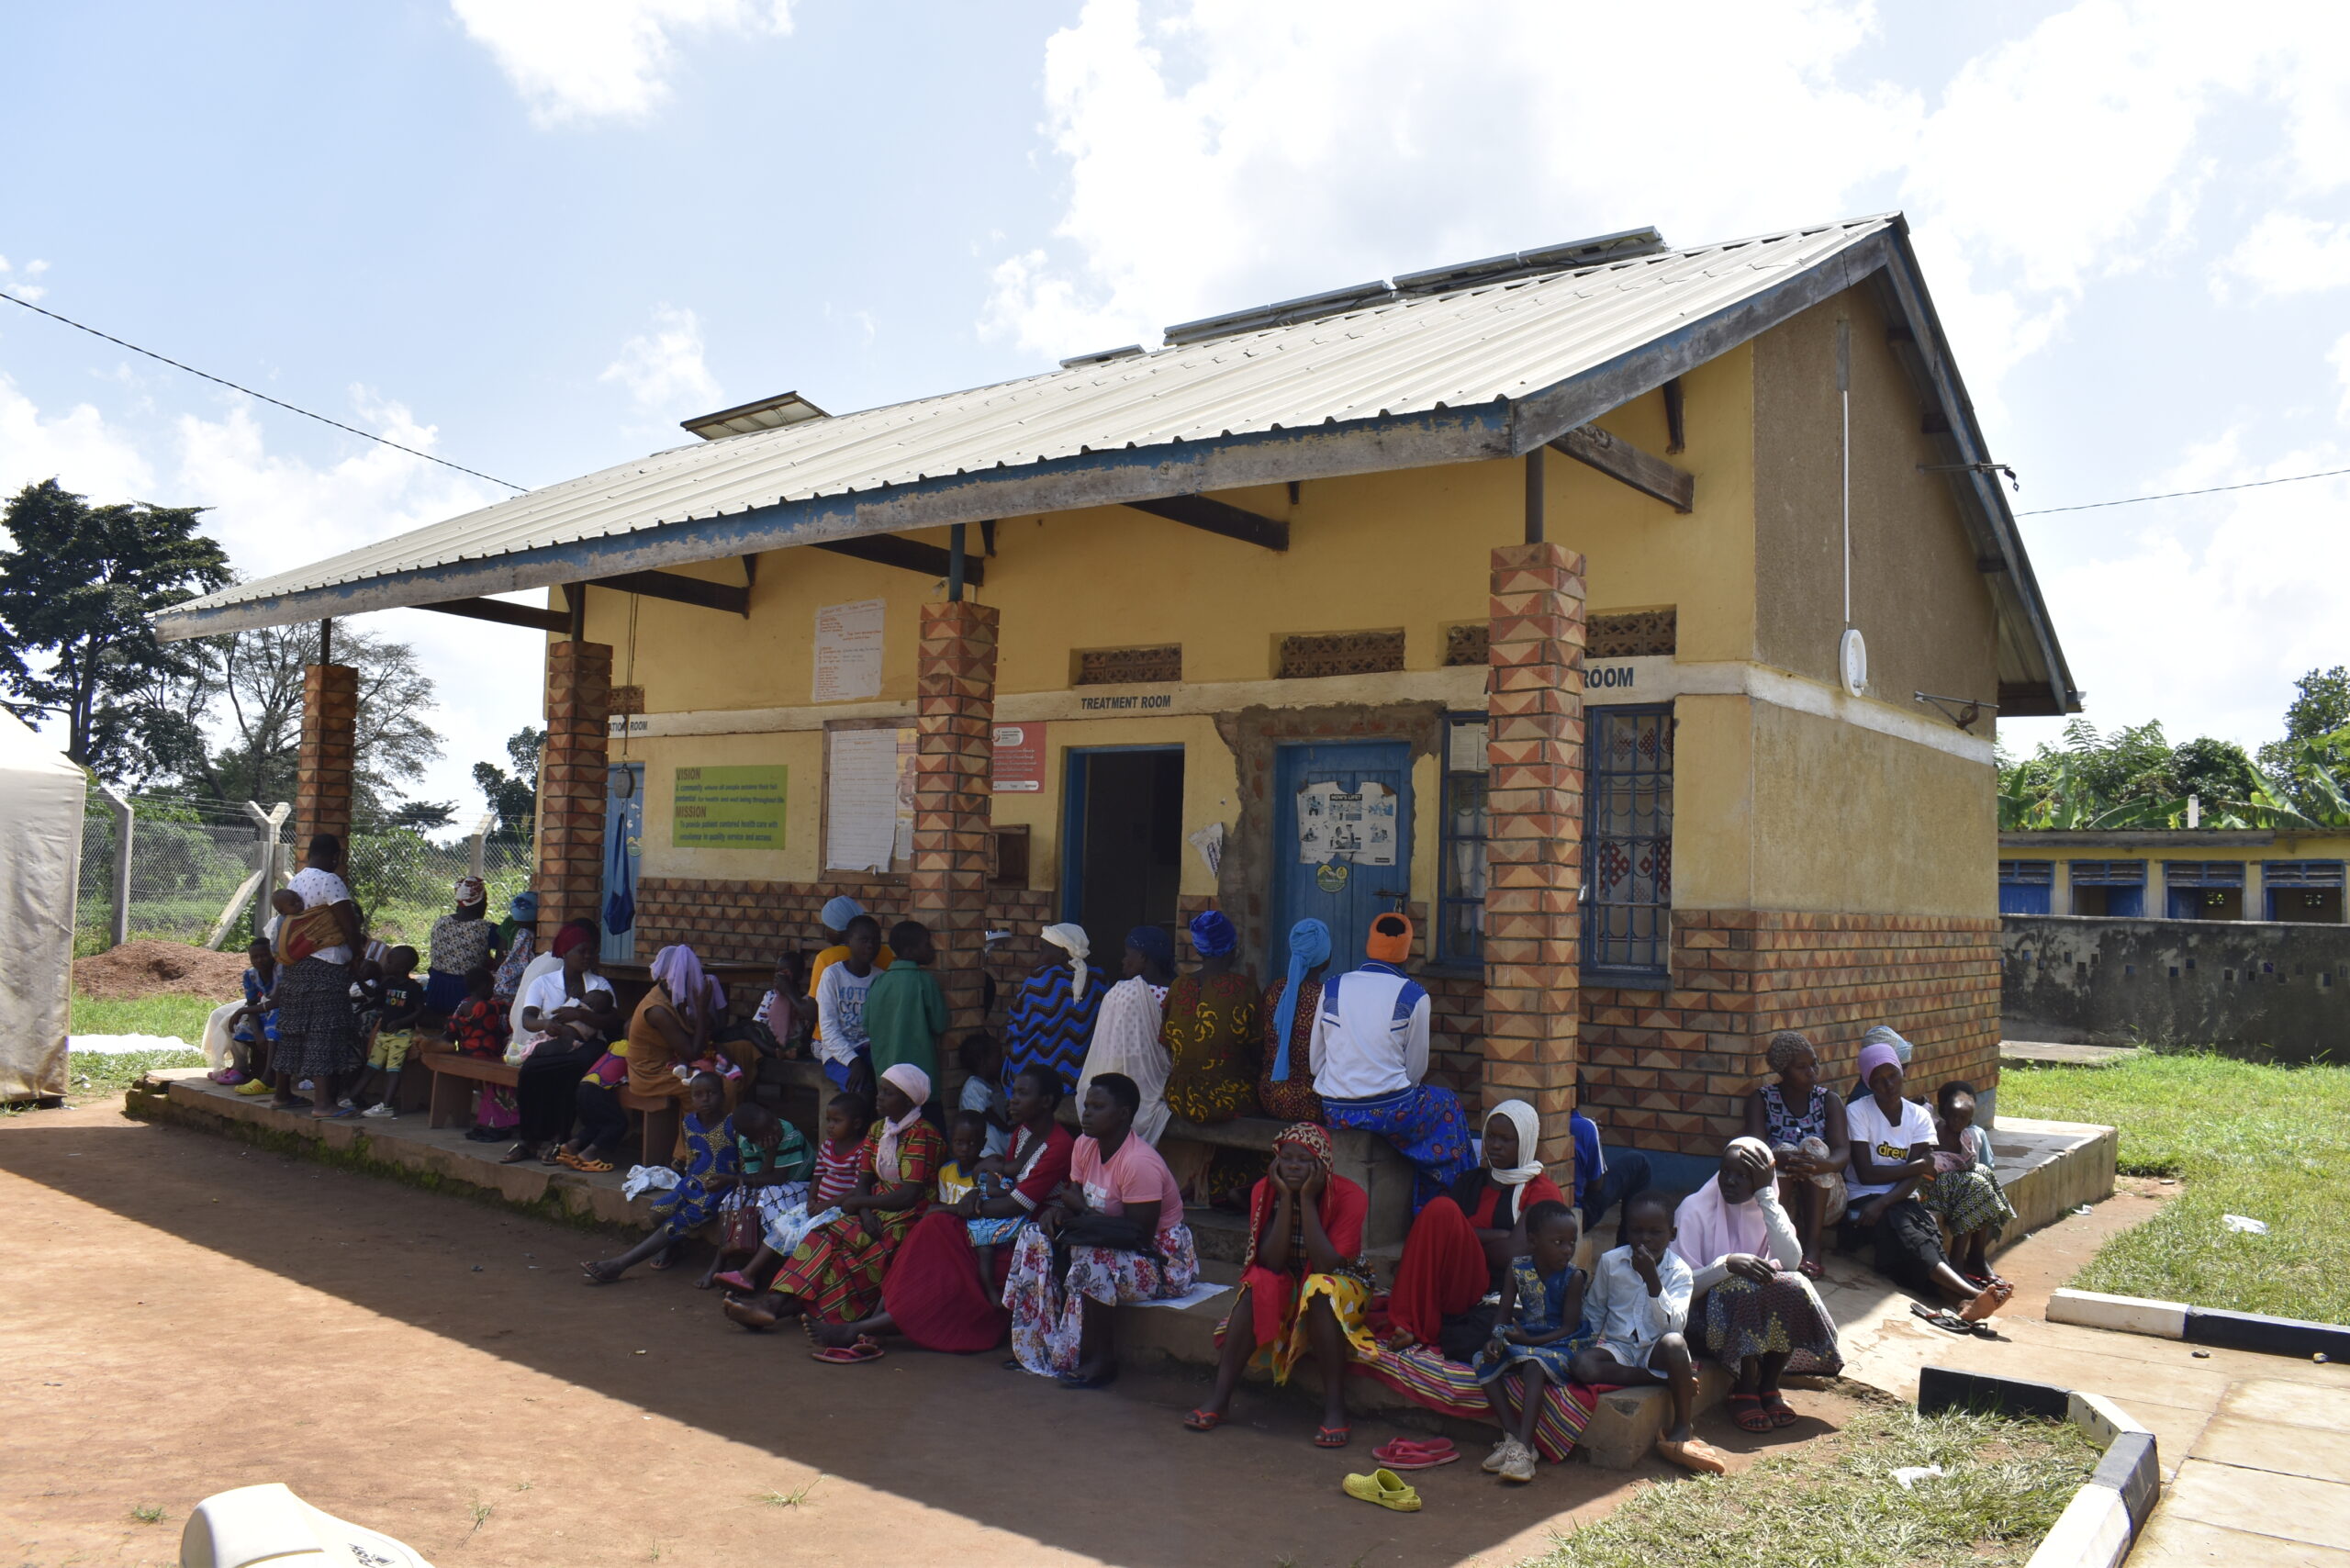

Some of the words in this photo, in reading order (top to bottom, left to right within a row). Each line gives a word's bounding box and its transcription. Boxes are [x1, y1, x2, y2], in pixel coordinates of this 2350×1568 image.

[1081, 696, 1138, 710] TREATMENT
[1141, 695, 1171, 709] ROOM
[630, 721, 648, 731] ROOM
[676, 767, 701, 780] VISION
[676, 806, 707, 818] MISSION
[348, 1543, 376, 1568] PUSH
